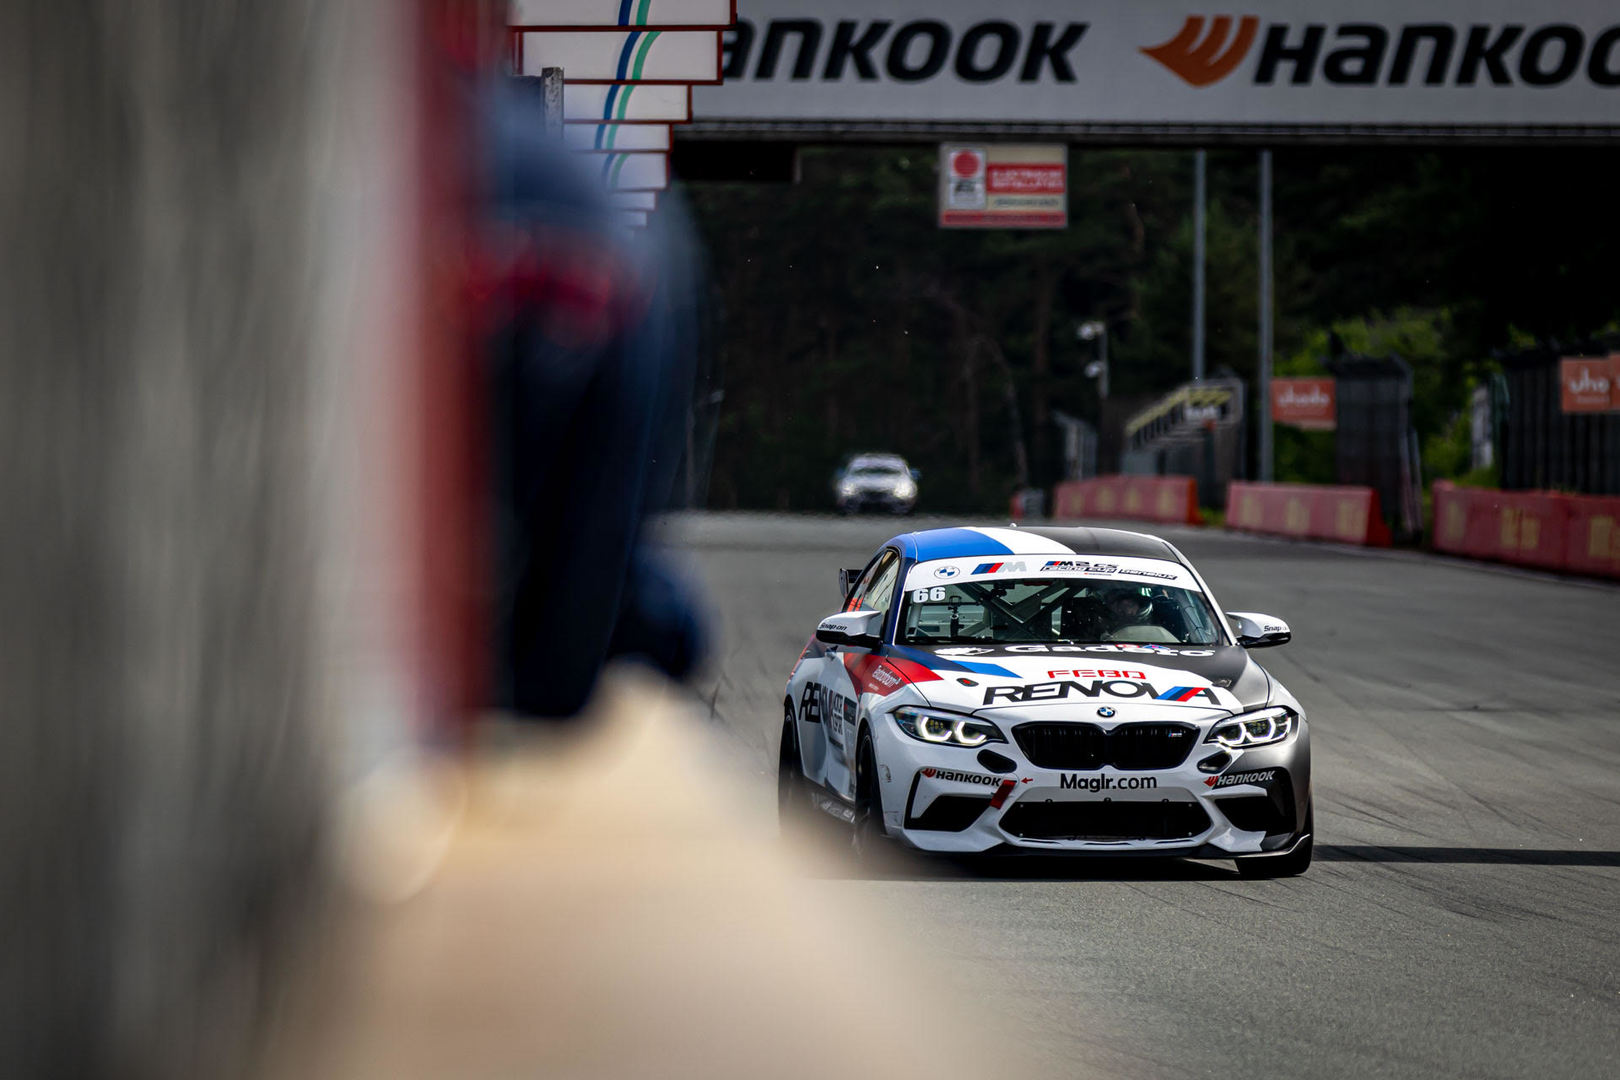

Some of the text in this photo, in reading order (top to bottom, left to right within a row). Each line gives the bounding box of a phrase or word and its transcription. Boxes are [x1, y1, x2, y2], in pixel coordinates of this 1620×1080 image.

[913, 588, 946, 603] 66
[1047, 669, 1147, 680] FEBO
[983, 679, 1222, 706] RENOVA
[1060, 773, 1158, 793] Maglr.com
